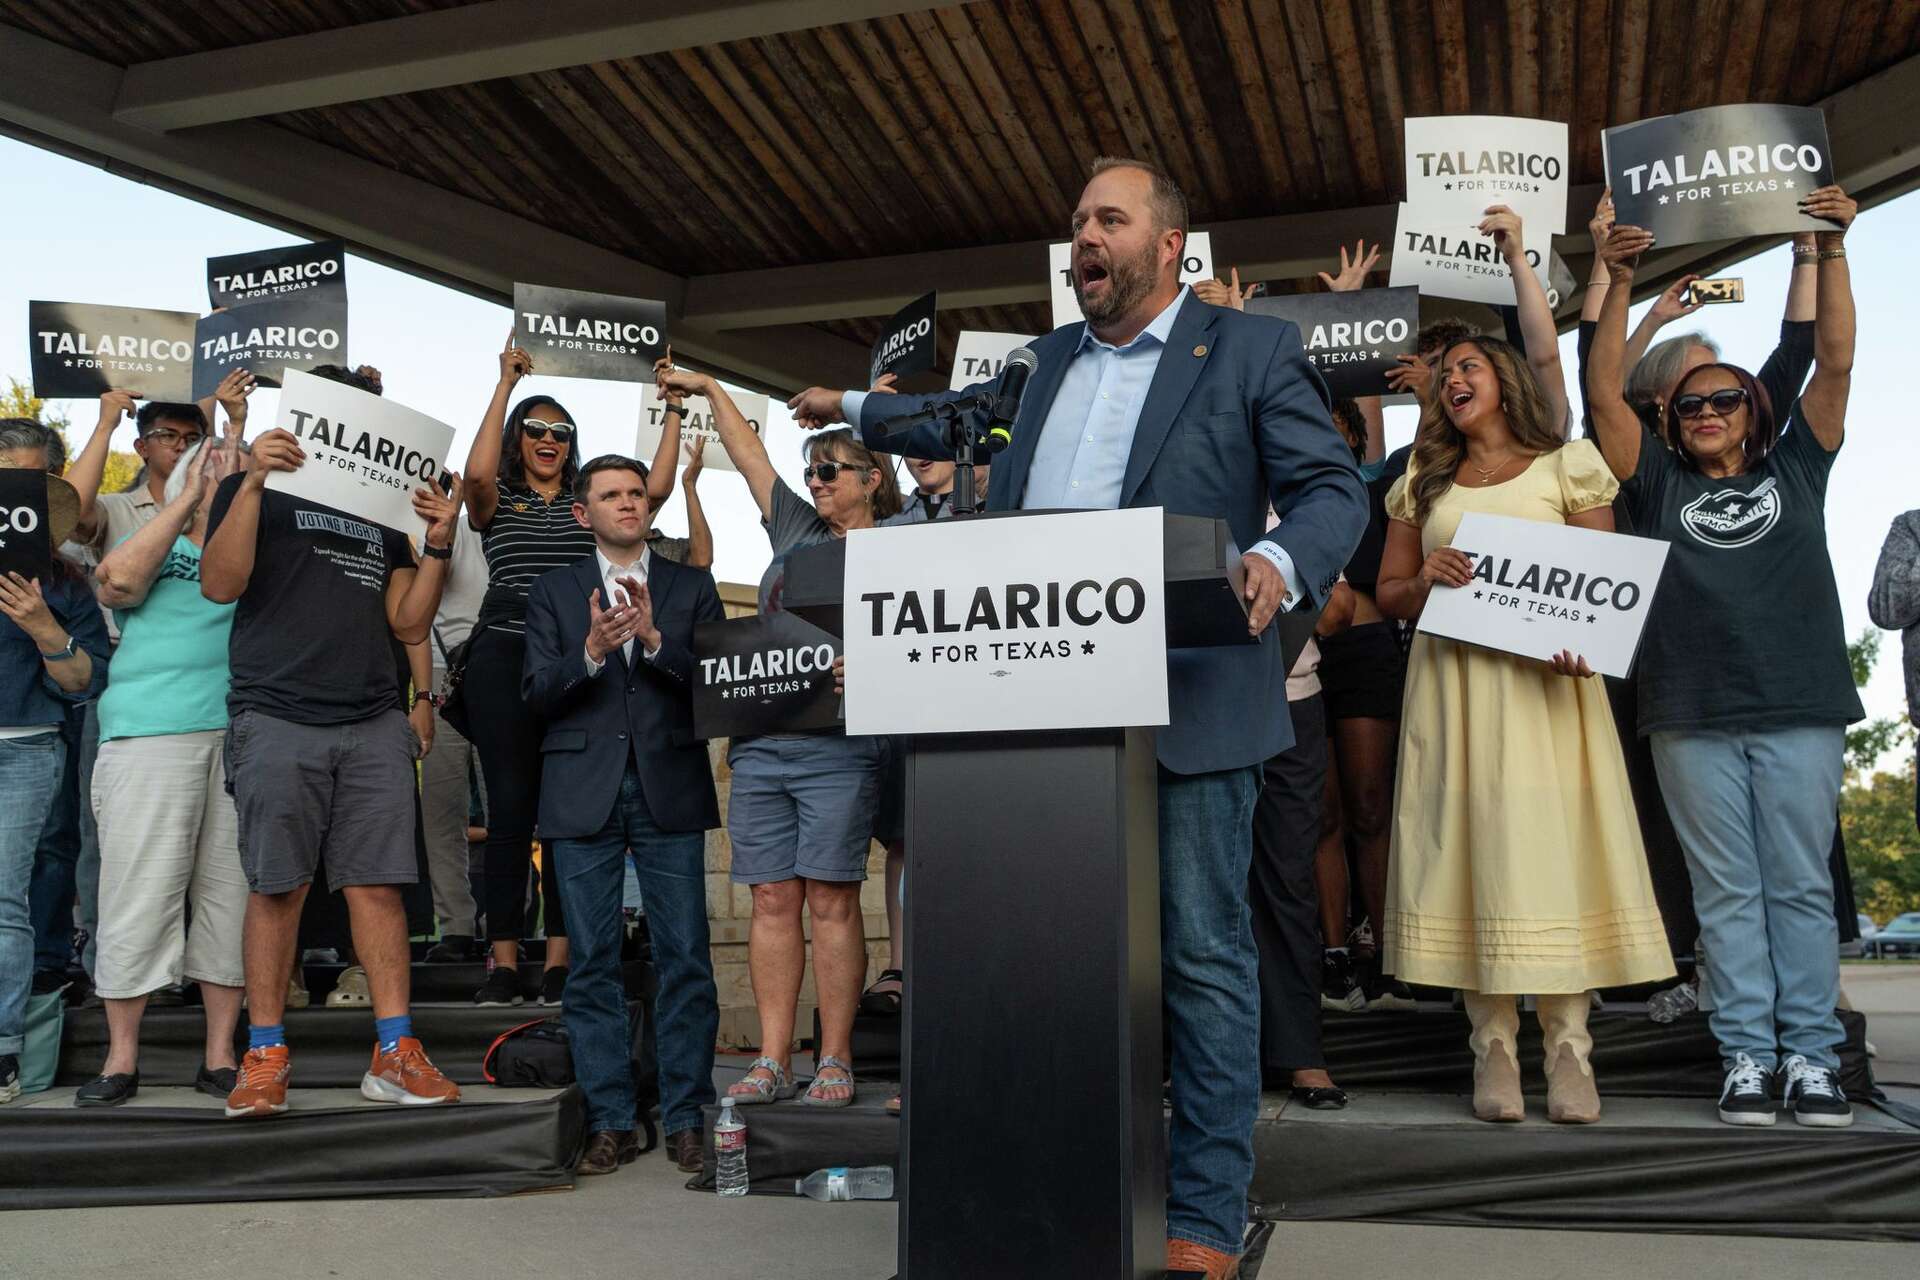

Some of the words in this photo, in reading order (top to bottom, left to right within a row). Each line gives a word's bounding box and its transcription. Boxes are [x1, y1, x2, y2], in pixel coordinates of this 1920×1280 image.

[1416, 151, 1561, 181] TALARICO
[1623, 143, 1822, 195] TALARICO
[1458, 180, 1484, 191] FOR
[1490, 180, 1530, 193] TEXAS
[1677, 187, 1711, 203] FOR
[1719, 179, 1778, 197] TEXAS
[1405, 231, 1541, 268] TALARIO
[214, 260, 338, 292] TALARICO
[1436, 260, 1460, 271] FOR
[1466, 264, 1504, 278] TEXAS
[247, 288, 268, 298] FOR
[272, 282, 307, 293] TEXAS
[523, 312, 659, 345] TALARICO
[1303, 318, 1408, 350] ARICO
[38, 332, 192, 362] TALARICO
[200, 327, 339, 360] TALARICO
[228, 351, 252, 362] FOR
[257, 350, 300, 360] TEXAS
[559, 340, 582, 350] FOR
[587, 342, 626, 354] TEXAS
[872, 317, 930, 372] ALARICO
[884, 347, 907, 365] TEXAS
[1322, 351, 1367, 364] TEXAS
[77, 359, 103, 369] FOR
[109, 360, 153, 372] TEXAS
[290, 409, 436, 482] TALARICO
[680, 430, 693, 441] OR
[328, 455, 356, 473] FOR
[362, 466, 401, 489] TEXAS
[297, 512, 340, 531] VOTING
[344, 520, 383, 543] RIGHTS
[366, 543, 384, 558] ACT
[861, 577, 1146, 636] TALARICO
[1488, 592, 1520, 609] FOR
[1528, 600, 1581, 621] TEXAS
[700, 643, 835, 685] TALARICO
[932, 645, 978, 663] FOR
[989, 640, 1071, 661] TEXAS
[733, 686, 756, 698] FOR
[760, 680, 799, 695] TEXAS
